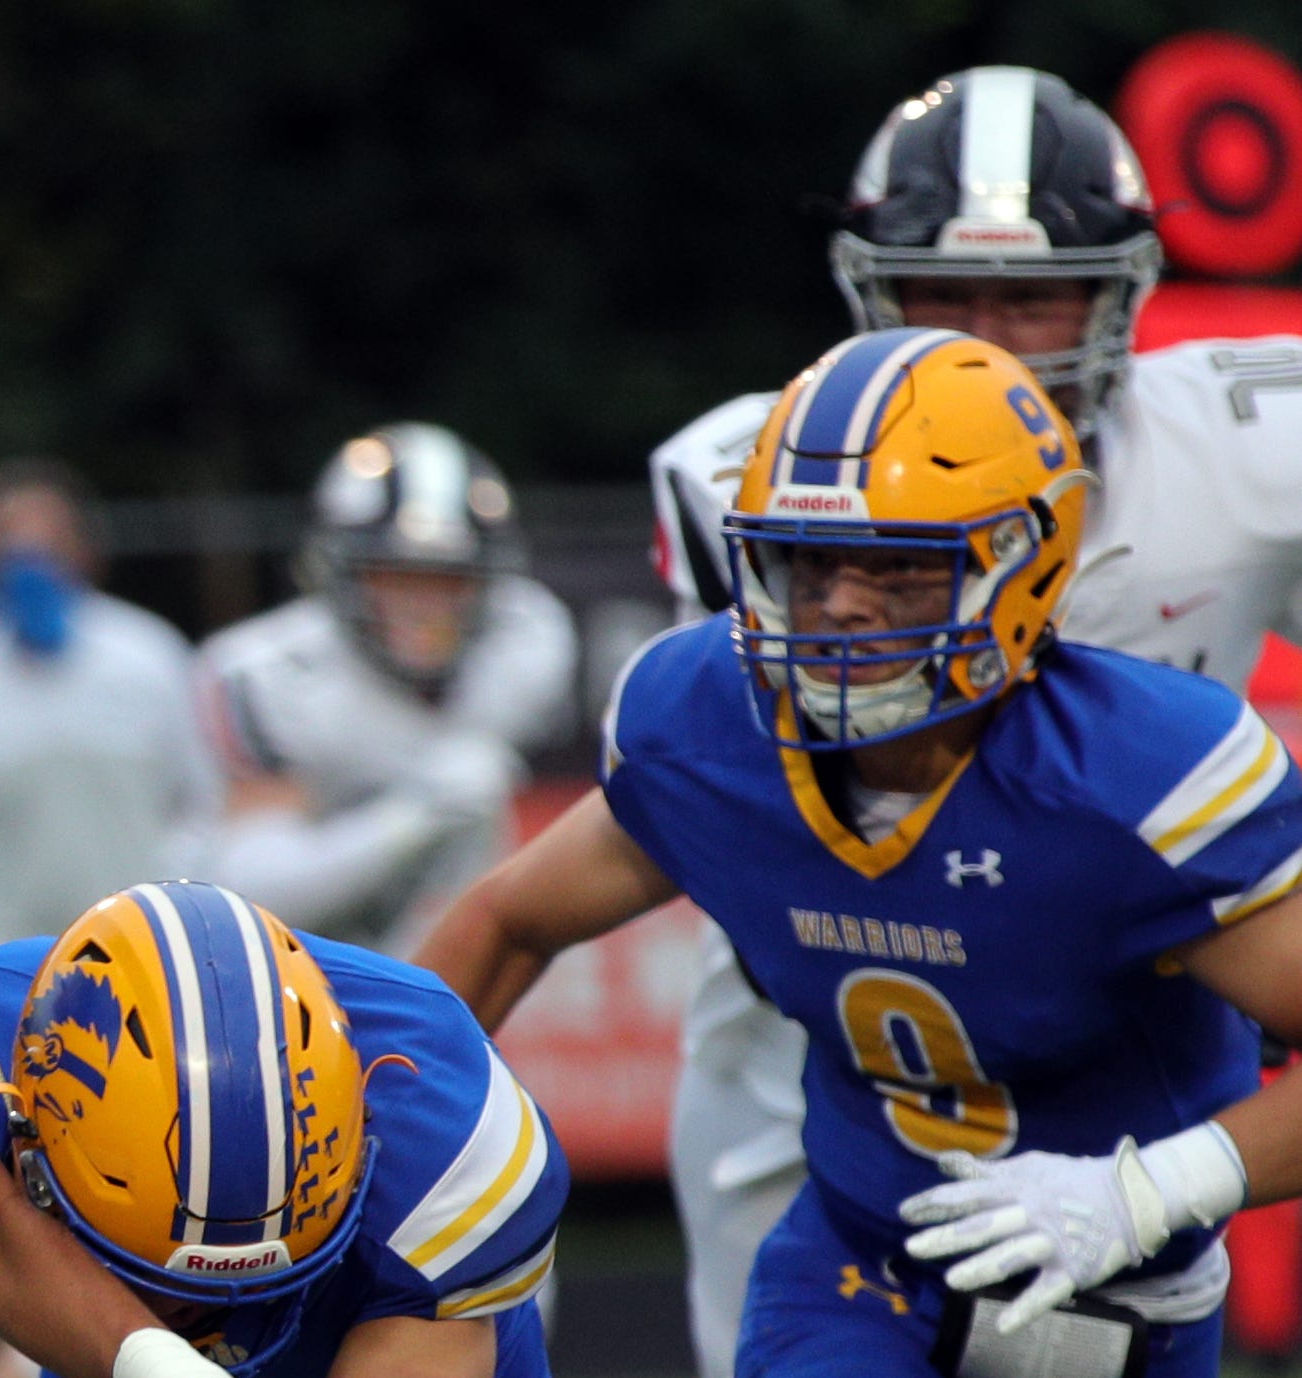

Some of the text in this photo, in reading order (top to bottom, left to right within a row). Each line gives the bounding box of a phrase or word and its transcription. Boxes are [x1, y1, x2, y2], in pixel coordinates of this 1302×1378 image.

[1007, 385, 1064, 470] 9
[789, 907, 967, 967] WARRIORS
[836, 966, 1019, 1161] 9
[186, 1250, 278, 1272] Riddell
